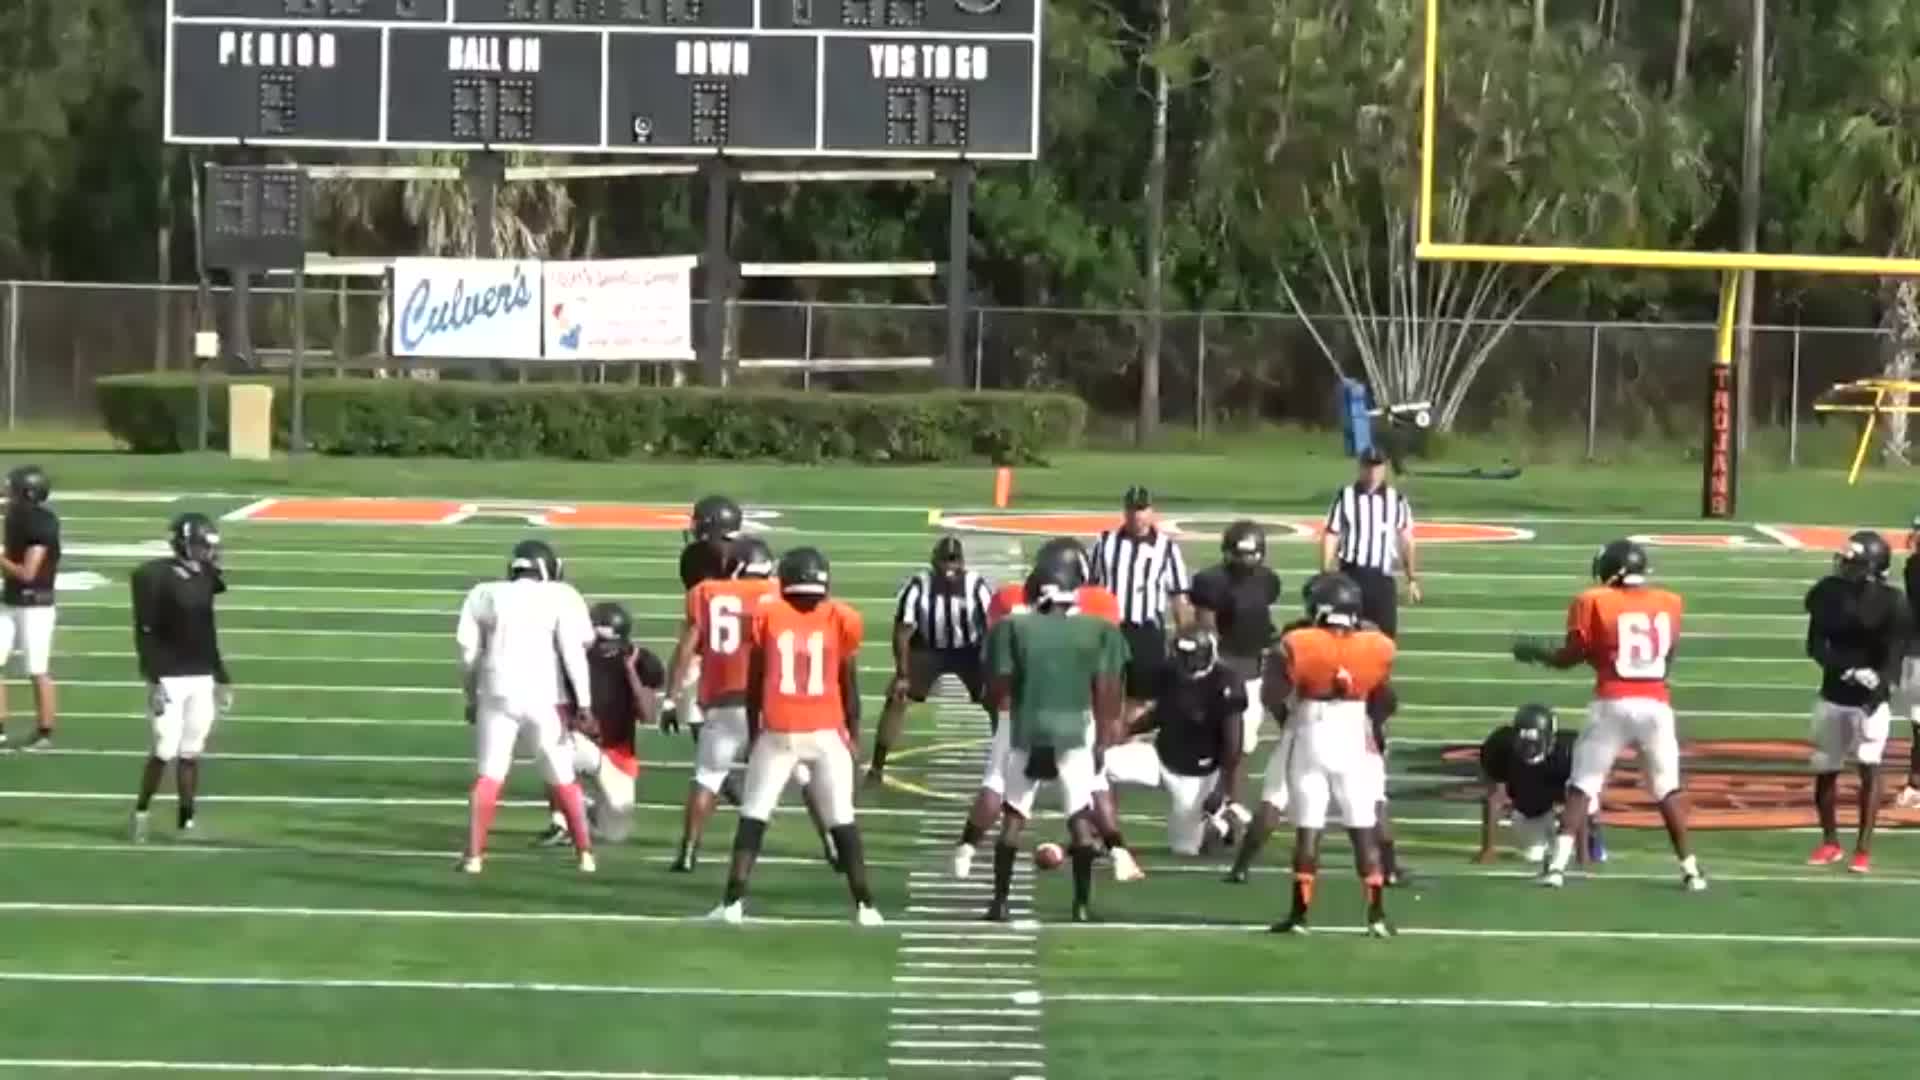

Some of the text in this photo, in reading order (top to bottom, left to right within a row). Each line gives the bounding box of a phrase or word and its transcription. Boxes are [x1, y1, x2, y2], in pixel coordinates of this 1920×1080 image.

[218, 31, 336, 68] PERIOD
[448, 36, 541, 72] BALL ON
[675, 41, 750, 76] DOWN
[869, 44, 989, 80] YDS TO GO
[399, 263, 532, 351] Culver's
[709, 594, 743, 655] 6
[1614, 611, 1672, 679] 61
[776, 629, 825, 697] 11
